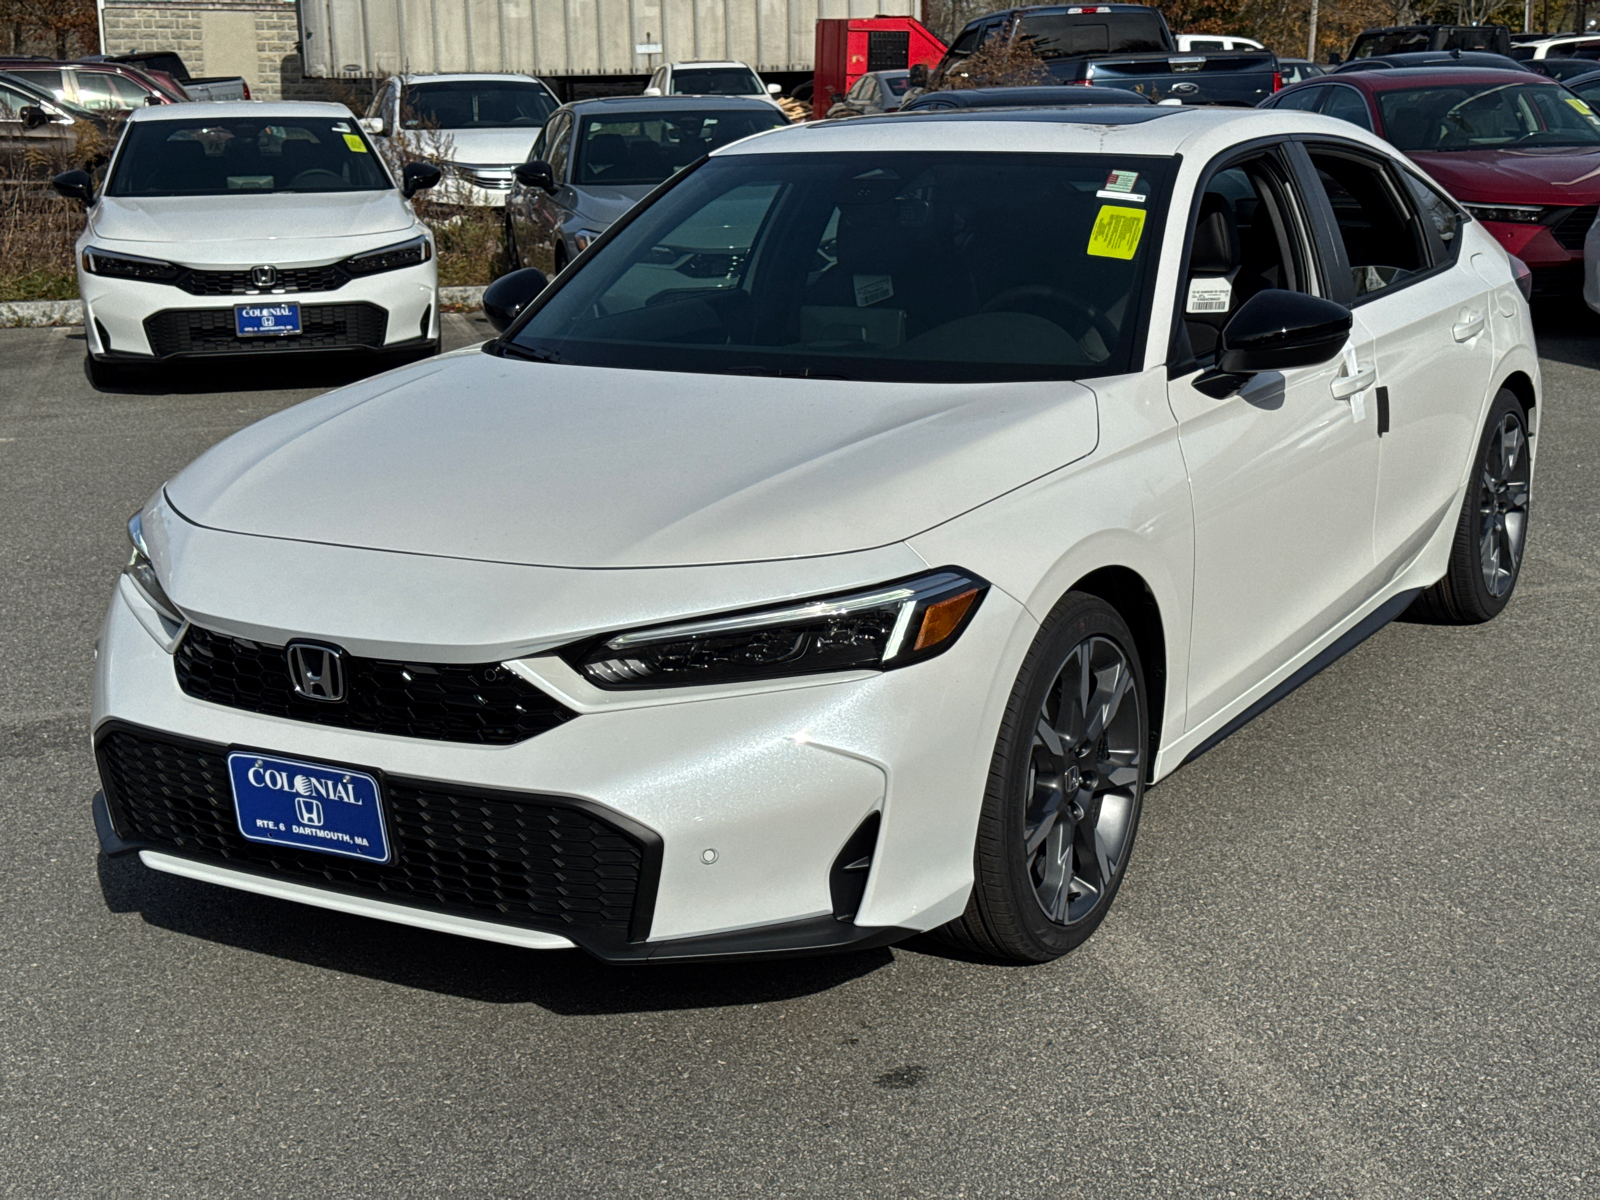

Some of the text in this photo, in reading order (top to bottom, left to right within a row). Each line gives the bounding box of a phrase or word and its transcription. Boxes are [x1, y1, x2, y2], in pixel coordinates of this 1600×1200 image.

[242, 308, 292, 317] COLONIAL
[248, 767, 362, 805] COLONIAL
[256, 819, 369, 847] RTE. 6 DARTMOUTH, MA
